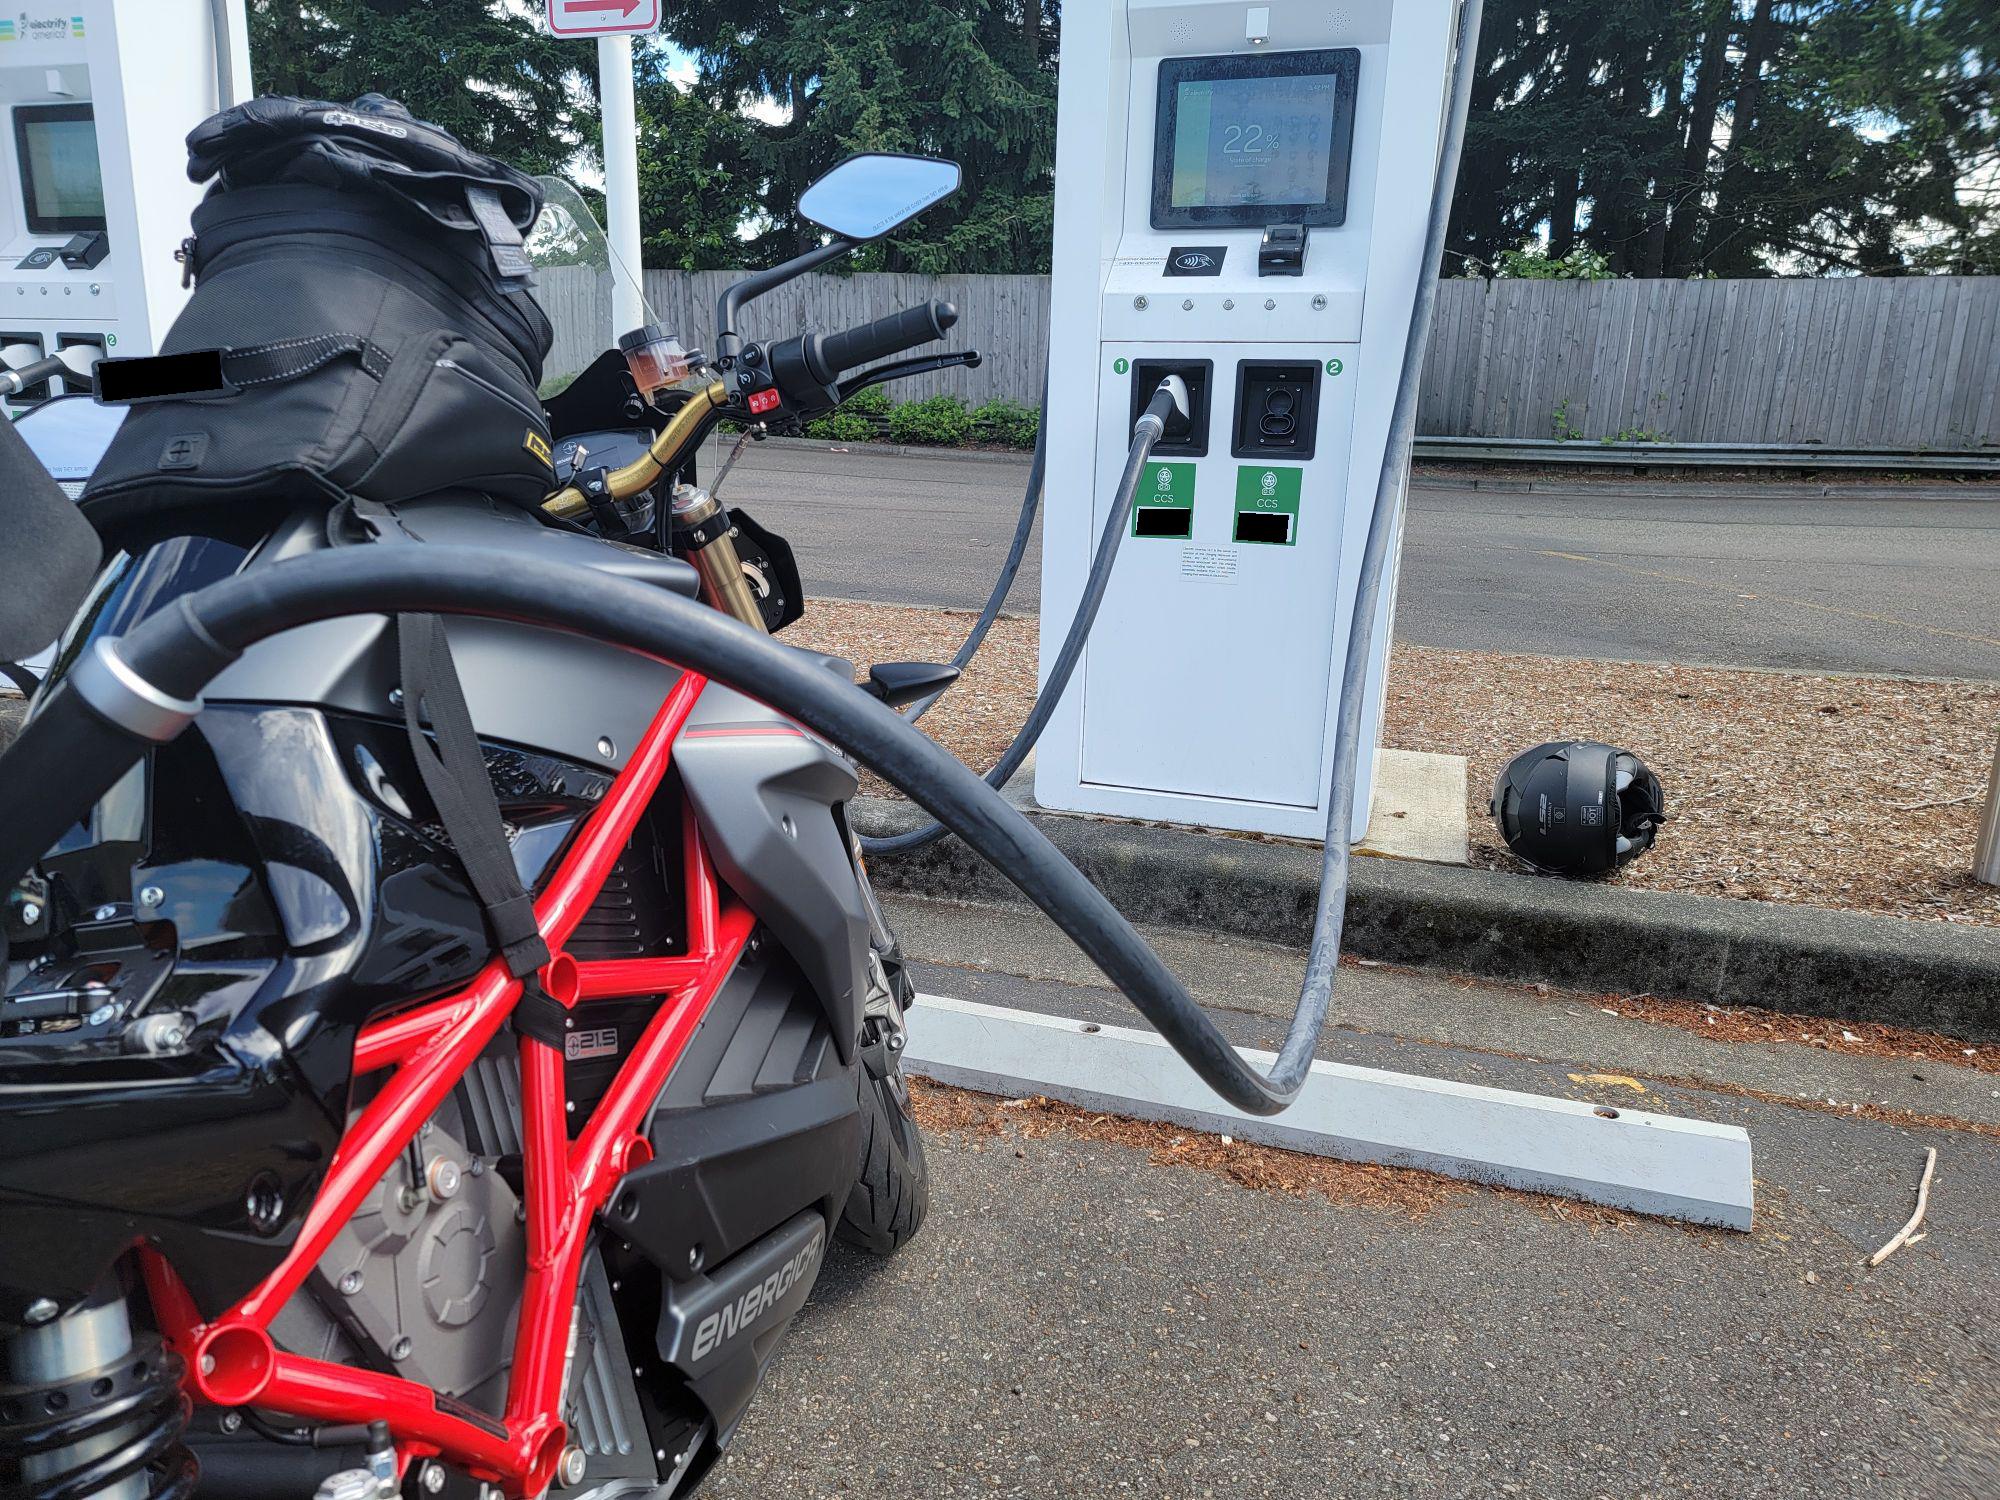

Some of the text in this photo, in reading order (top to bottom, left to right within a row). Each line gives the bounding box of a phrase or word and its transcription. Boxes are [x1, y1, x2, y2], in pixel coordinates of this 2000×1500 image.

[29, 18, 67, 29] electrify
[1223, 124, 1280, 154] 22%
[1329, 361, 1339, 374] 2
[1153, 494, 1174, 503] CCS
[1256, 498, 1278, 508] CCS
[1539, 793, 1547, 835] LS2
[1588, 808, 1596, 825] DOT
